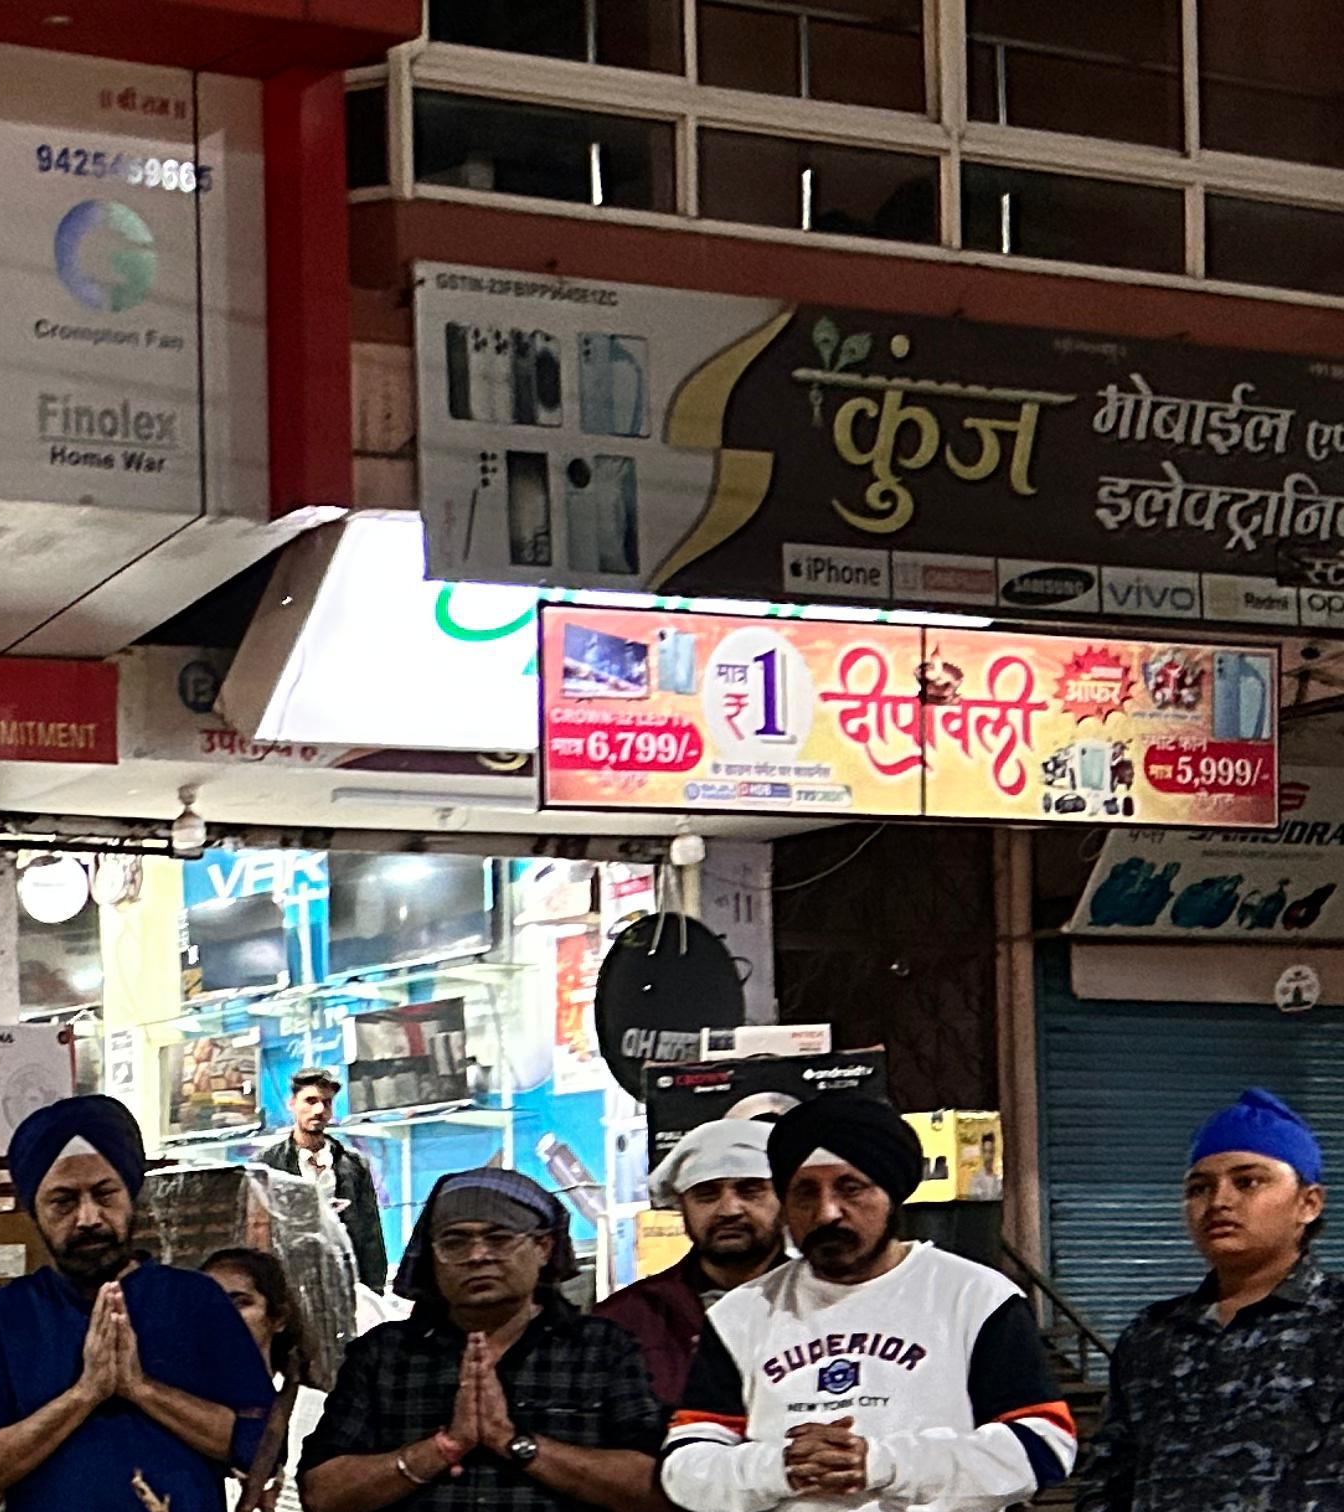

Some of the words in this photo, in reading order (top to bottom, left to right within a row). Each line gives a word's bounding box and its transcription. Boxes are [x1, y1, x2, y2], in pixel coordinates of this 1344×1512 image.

[34, 317, 140, 347] Crompton
[36, 392, 178, 441] Finolex
[794, 334, 1076, 533] कुंज
[50, 445, 115, 470] Home
[806, 556, 882, 587] iPhone
[1013, 577, 1085, 597] SAMSUNG
[1109, 576, 1196, 612] vivo
[753, 647, 786, 737] 1
[819, 645, 1049, 797] दीपावली
[587, 729, 700, 764] 6,799/-
[1176, 756, 1270, 788] 5,999/-
[762, 1331, 928, 1385] SUPERIOR
[787, 1401, 817, 1414] NEW
[822, 1398, 854, 1412] YORK
[860, 1395, 891, 1410] CITY
